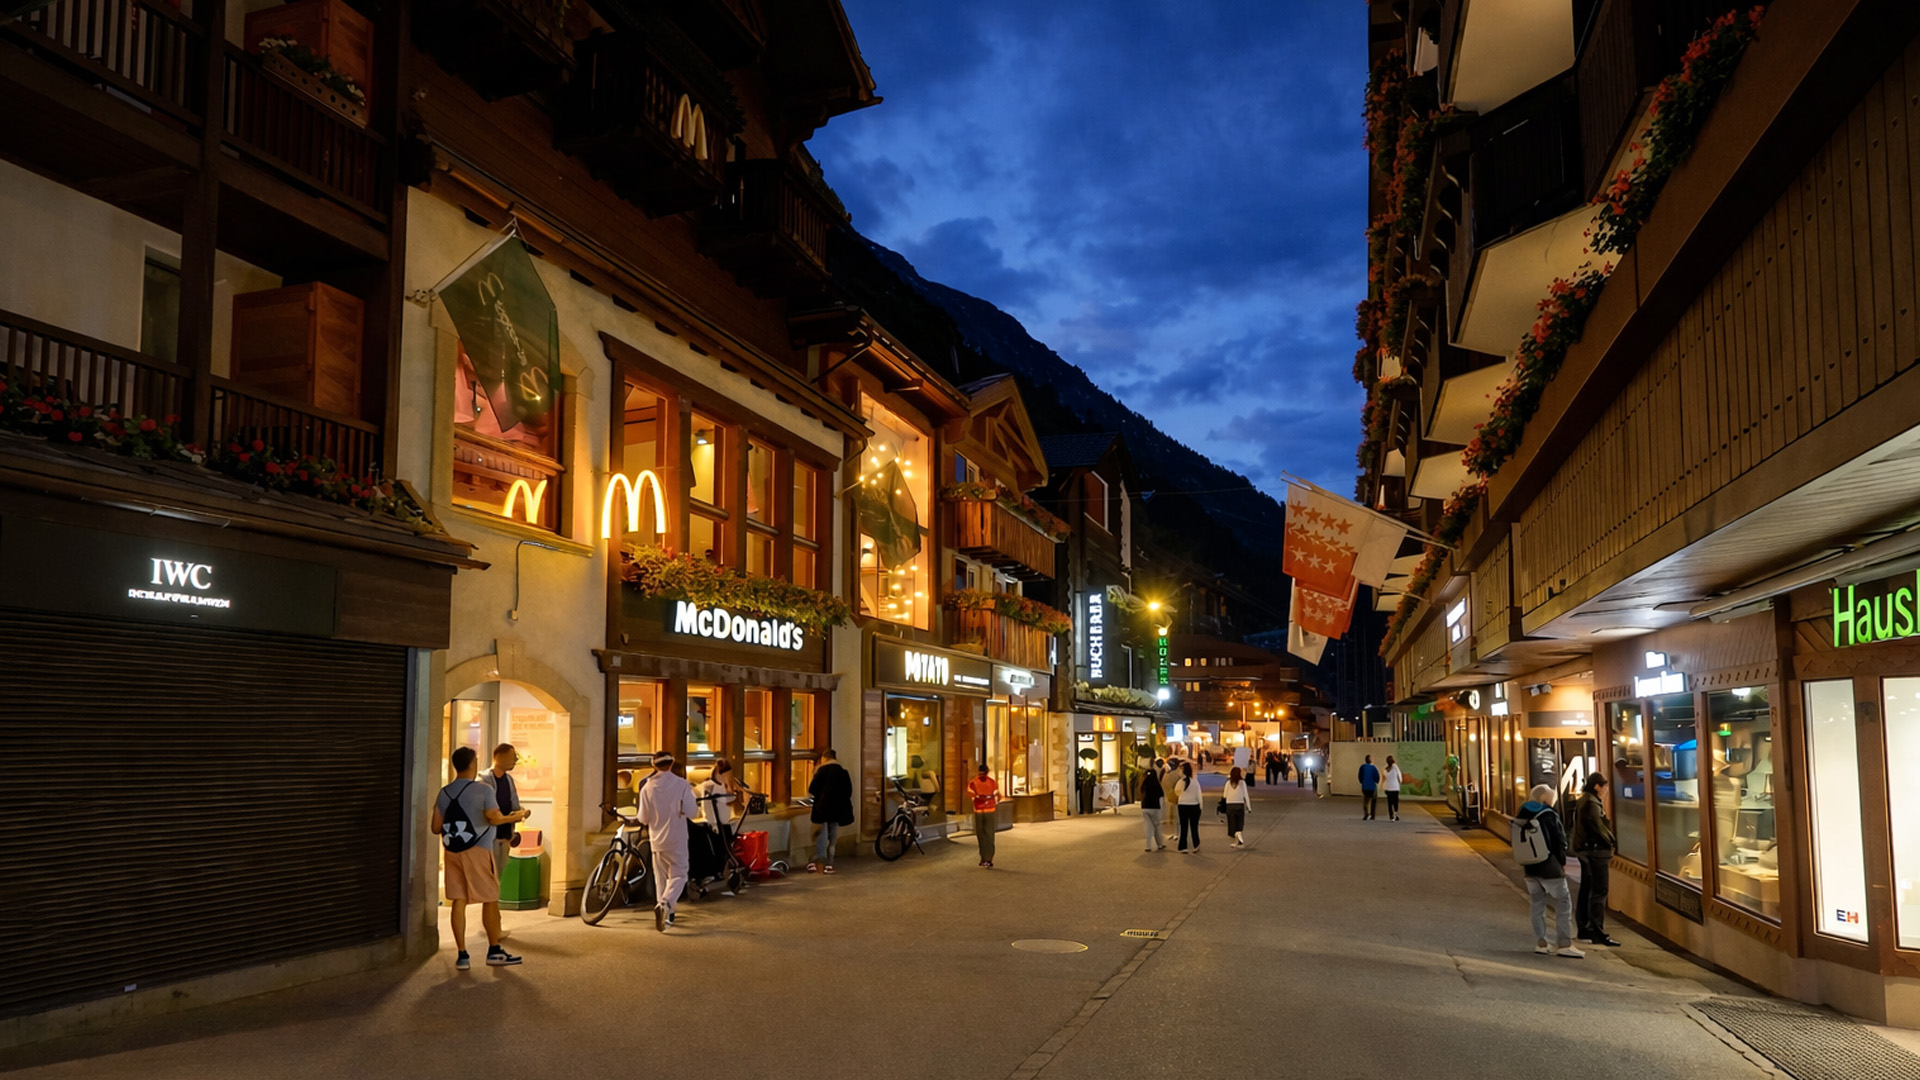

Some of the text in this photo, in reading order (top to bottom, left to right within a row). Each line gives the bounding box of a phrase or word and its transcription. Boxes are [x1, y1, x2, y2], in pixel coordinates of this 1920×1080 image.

[150, 557, 212, 590] IWC
[674, 600, 804, 651] McDonald's
[904, 650, 949, 686] POTATO
[1836, 909, 1859, 924] EH
